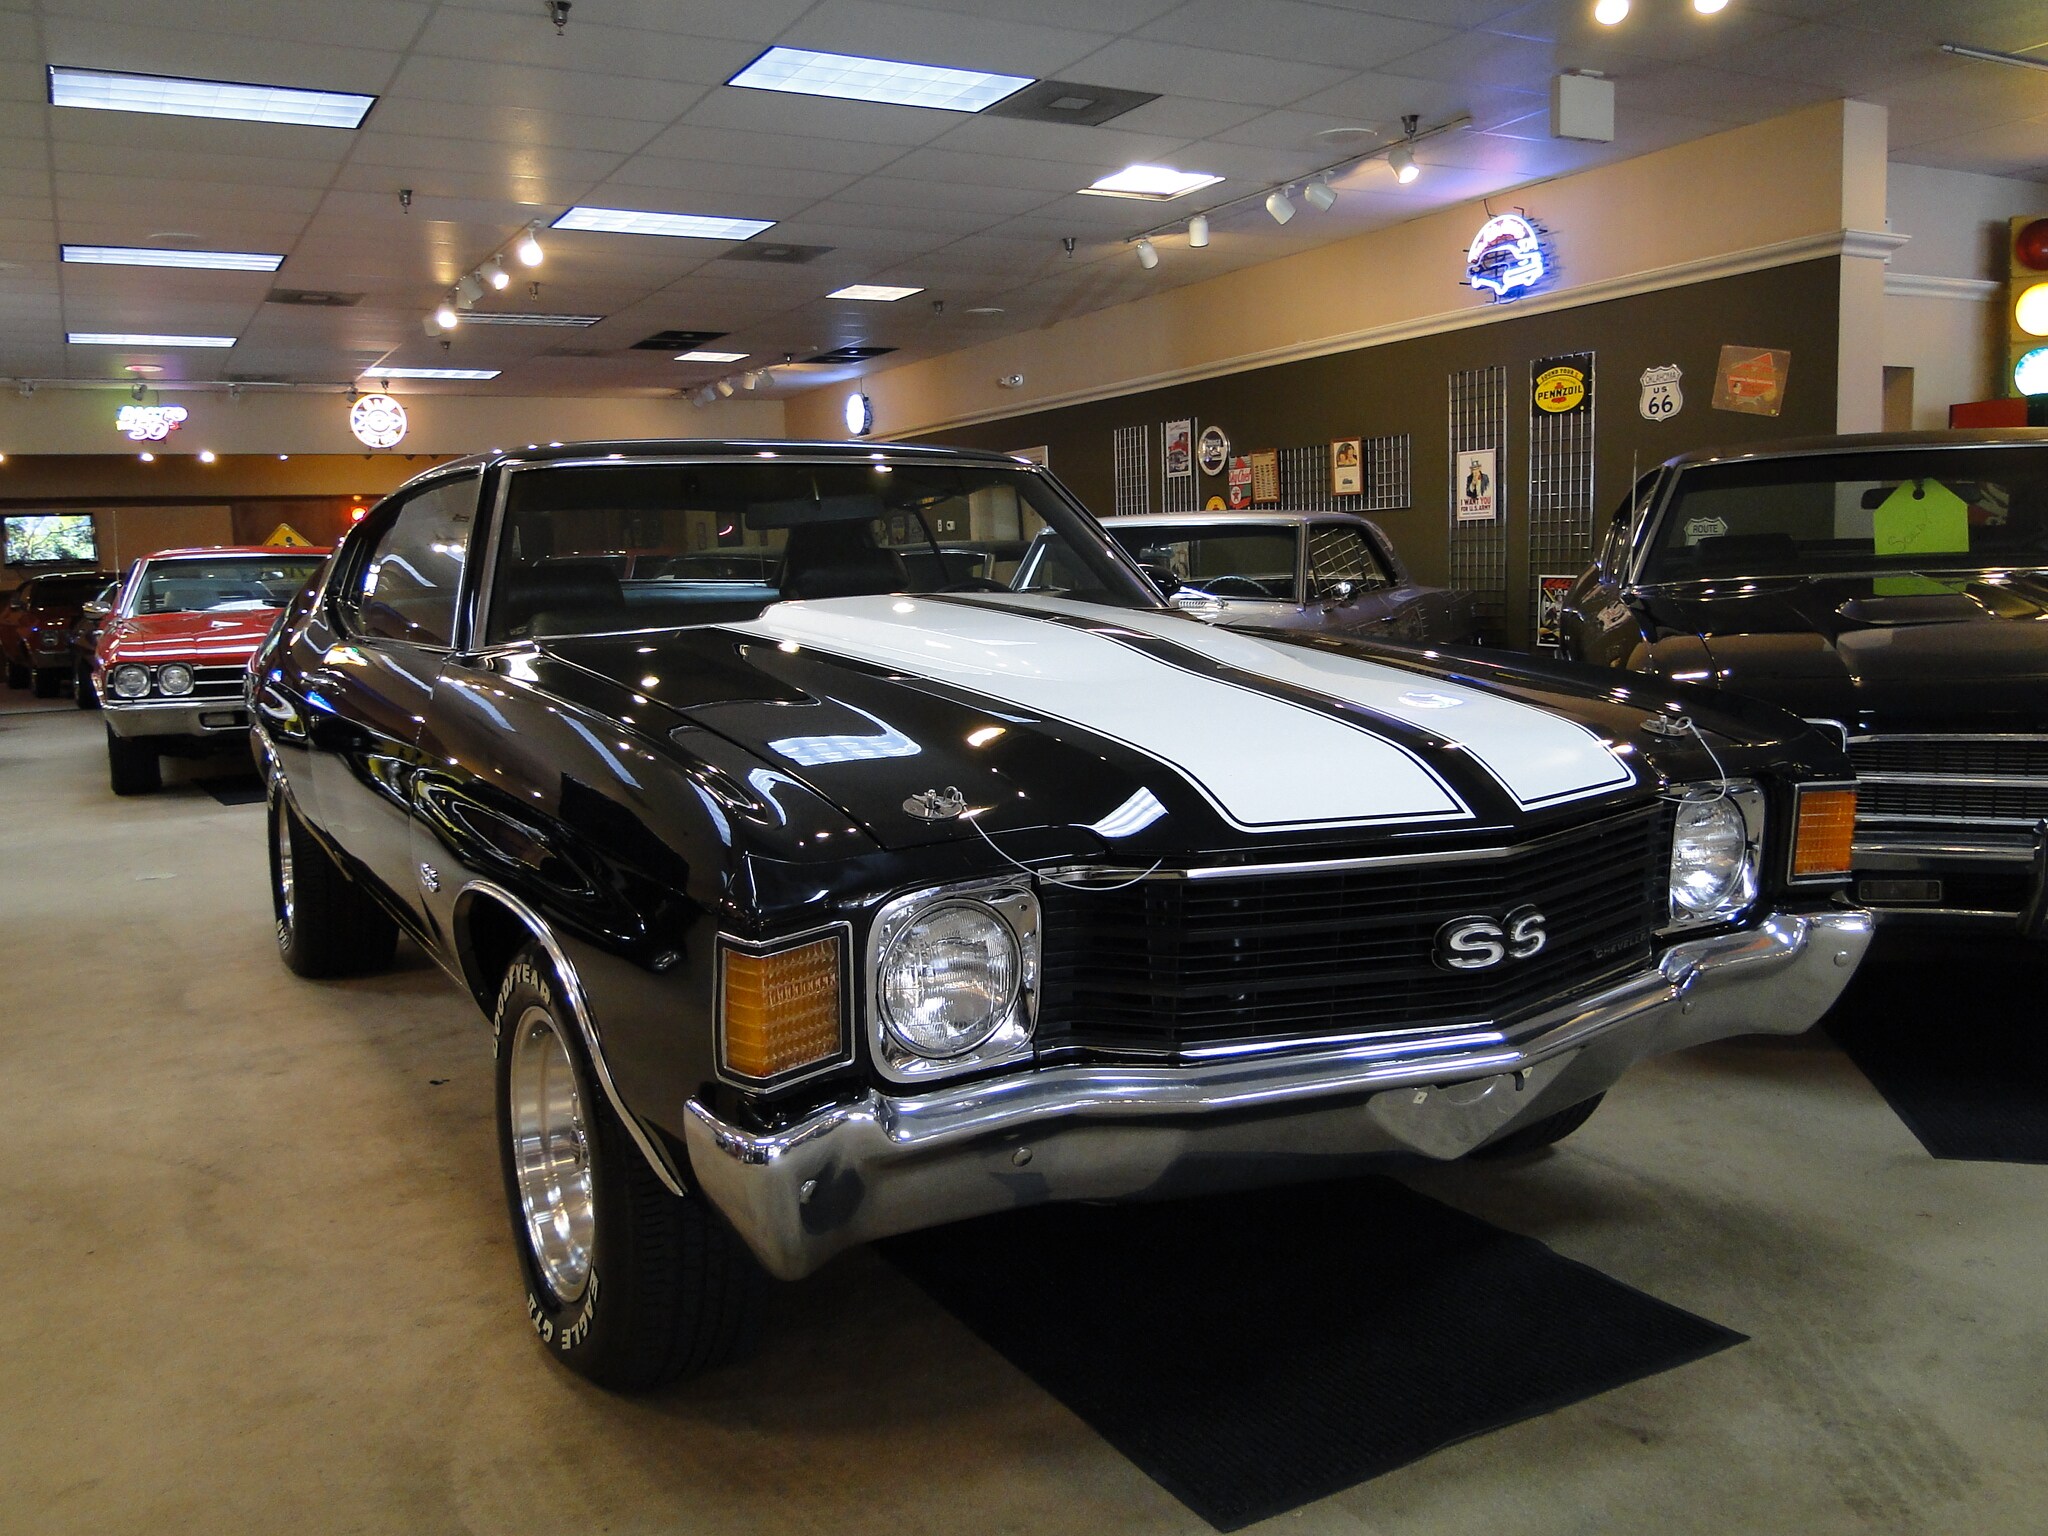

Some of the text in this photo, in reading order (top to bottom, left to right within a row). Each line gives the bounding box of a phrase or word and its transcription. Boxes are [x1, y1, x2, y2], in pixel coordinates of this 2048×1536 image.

[1537, 384, 1583, 402] PENNZOIL
[1653, 386, 1668, 394] US
[1648, 394, 1674, 415] 66
[1463, 497, 1480, 506] WANT
[1480, 495, 1492, 505] YOU
[1692, 524, 1719, 534] ROUTE
[1595, 933, 1649, 959] CHEVELLE
[492, 962, 552, 1060] GOODYEAR
[561, 1266, 599, 1350] EAGLE
